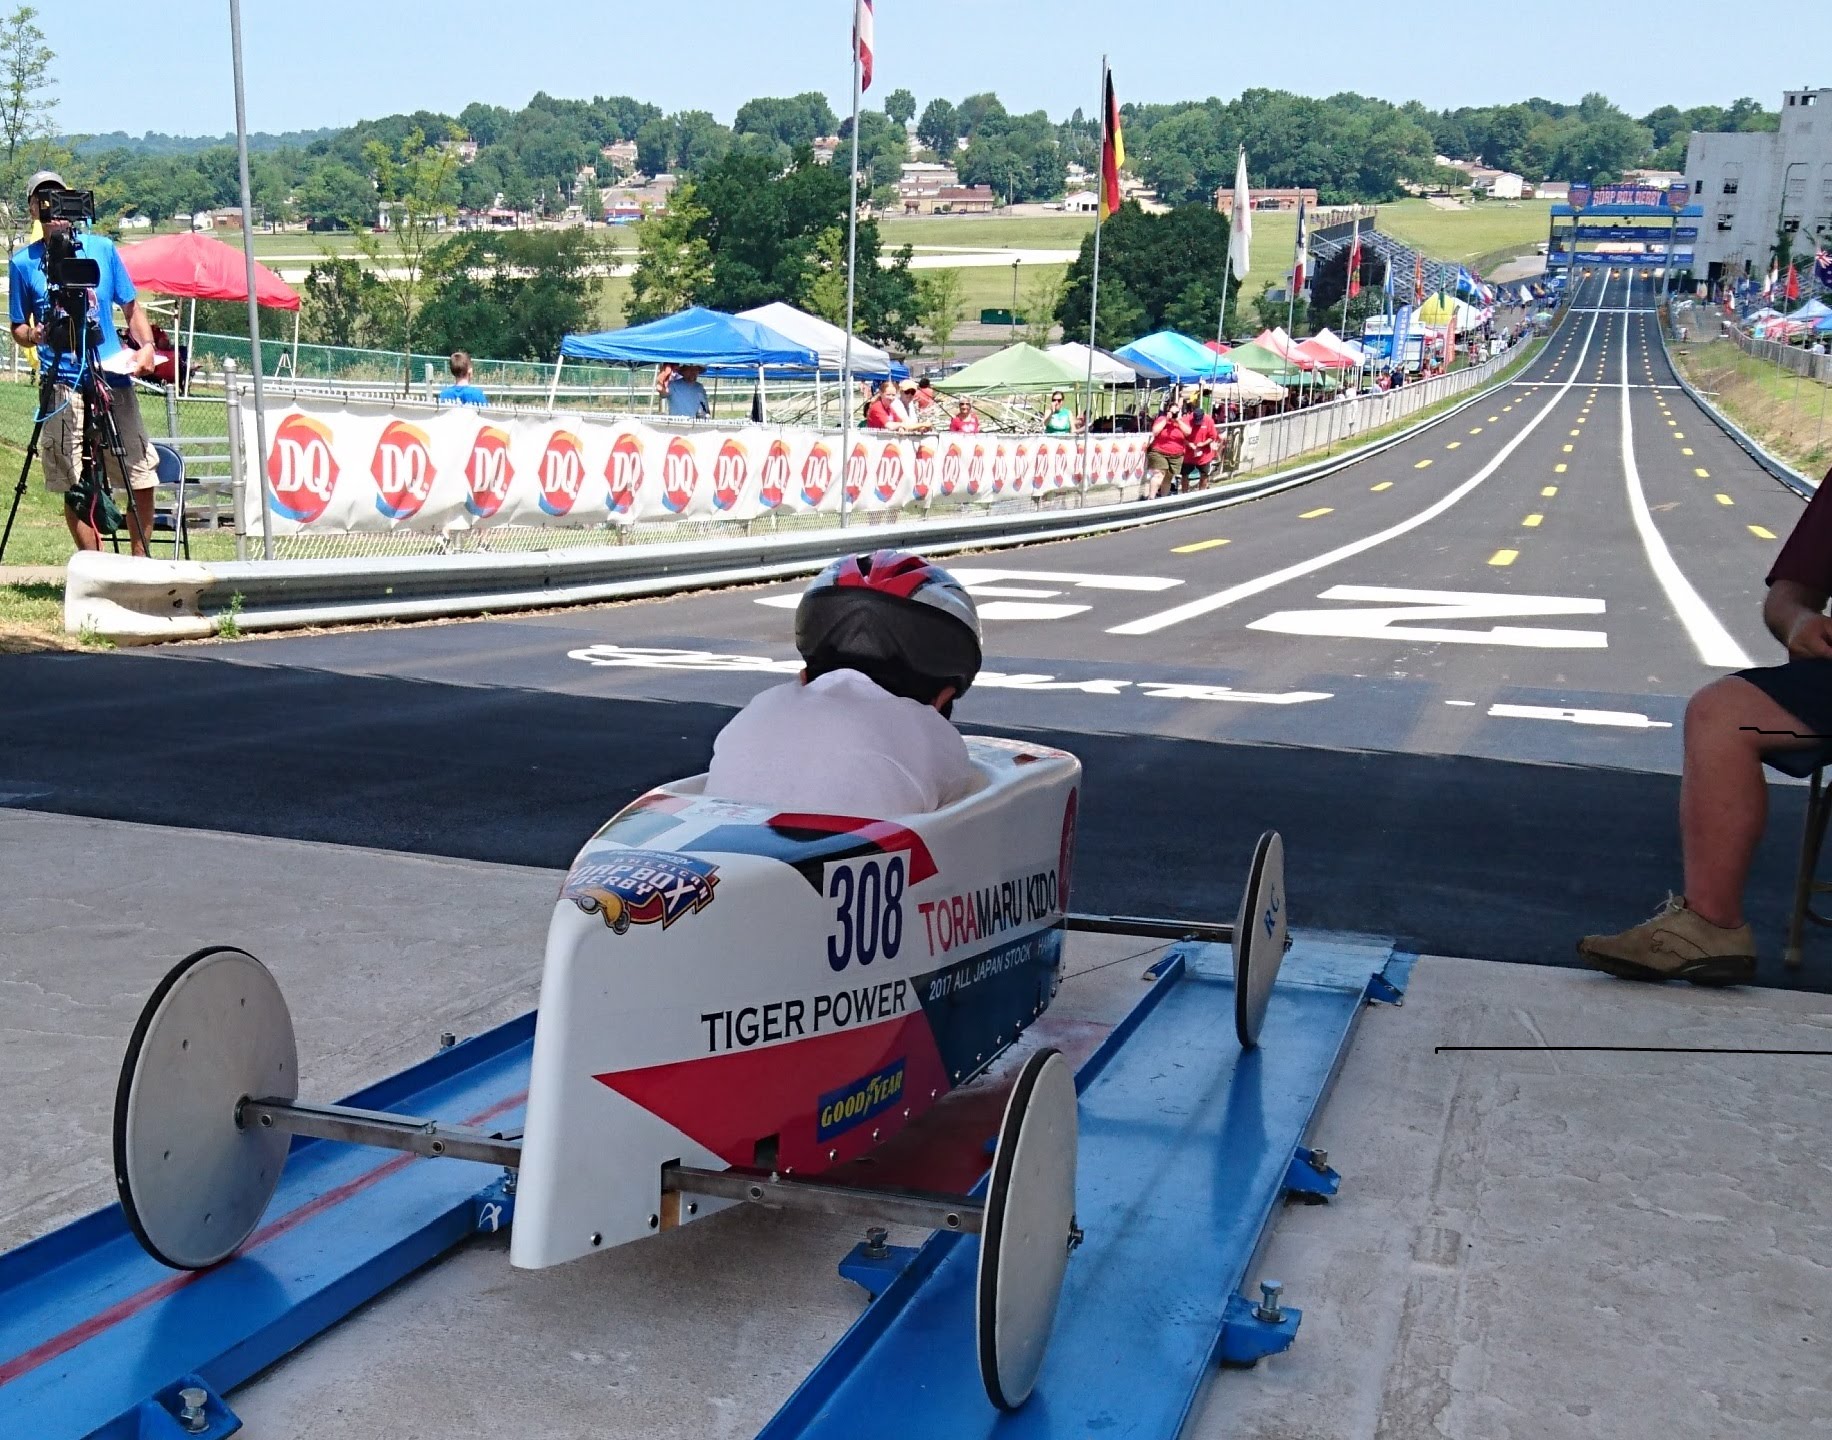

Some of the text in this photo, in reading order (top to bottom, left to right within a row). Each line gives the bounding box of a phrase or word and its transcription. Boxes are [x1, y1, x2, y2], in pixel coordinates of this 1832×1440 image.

[1593, 190, 1662, 206] SOAP BOX DERBY
[276, 438, 332, 501] DQ
[379, 443, 429, 500] DQ
[473, 447, 508, 500] DQ
[545, 450, 579, 500] DQ
[612, 451, 640, 497] DQ
[664, 453, 694, 499] DQ
[718, 455, 745, 496] DQ
[764, 455, 786, 494] DQ
[804, 456, 829, 492] DQ
[877, 456, 902, 492] DQ
[571, 874, 655, 896] DERBY
[630, 867, 696, 915] BOX
[827, 856, 904, 972] 308
[917, 869, 1057, 957] TORAMARU KIDO
[929, 976, 951, 1001] 2017
[954, 967, 971, 992] ALL
[974, 956, 1003, 983] JAPAN
[1004, 942, 1032, 971] STOCK
[701, 980, 907, 1052] TIGER POWER
[821, 1070, 904, 1128] GOODYEAR
